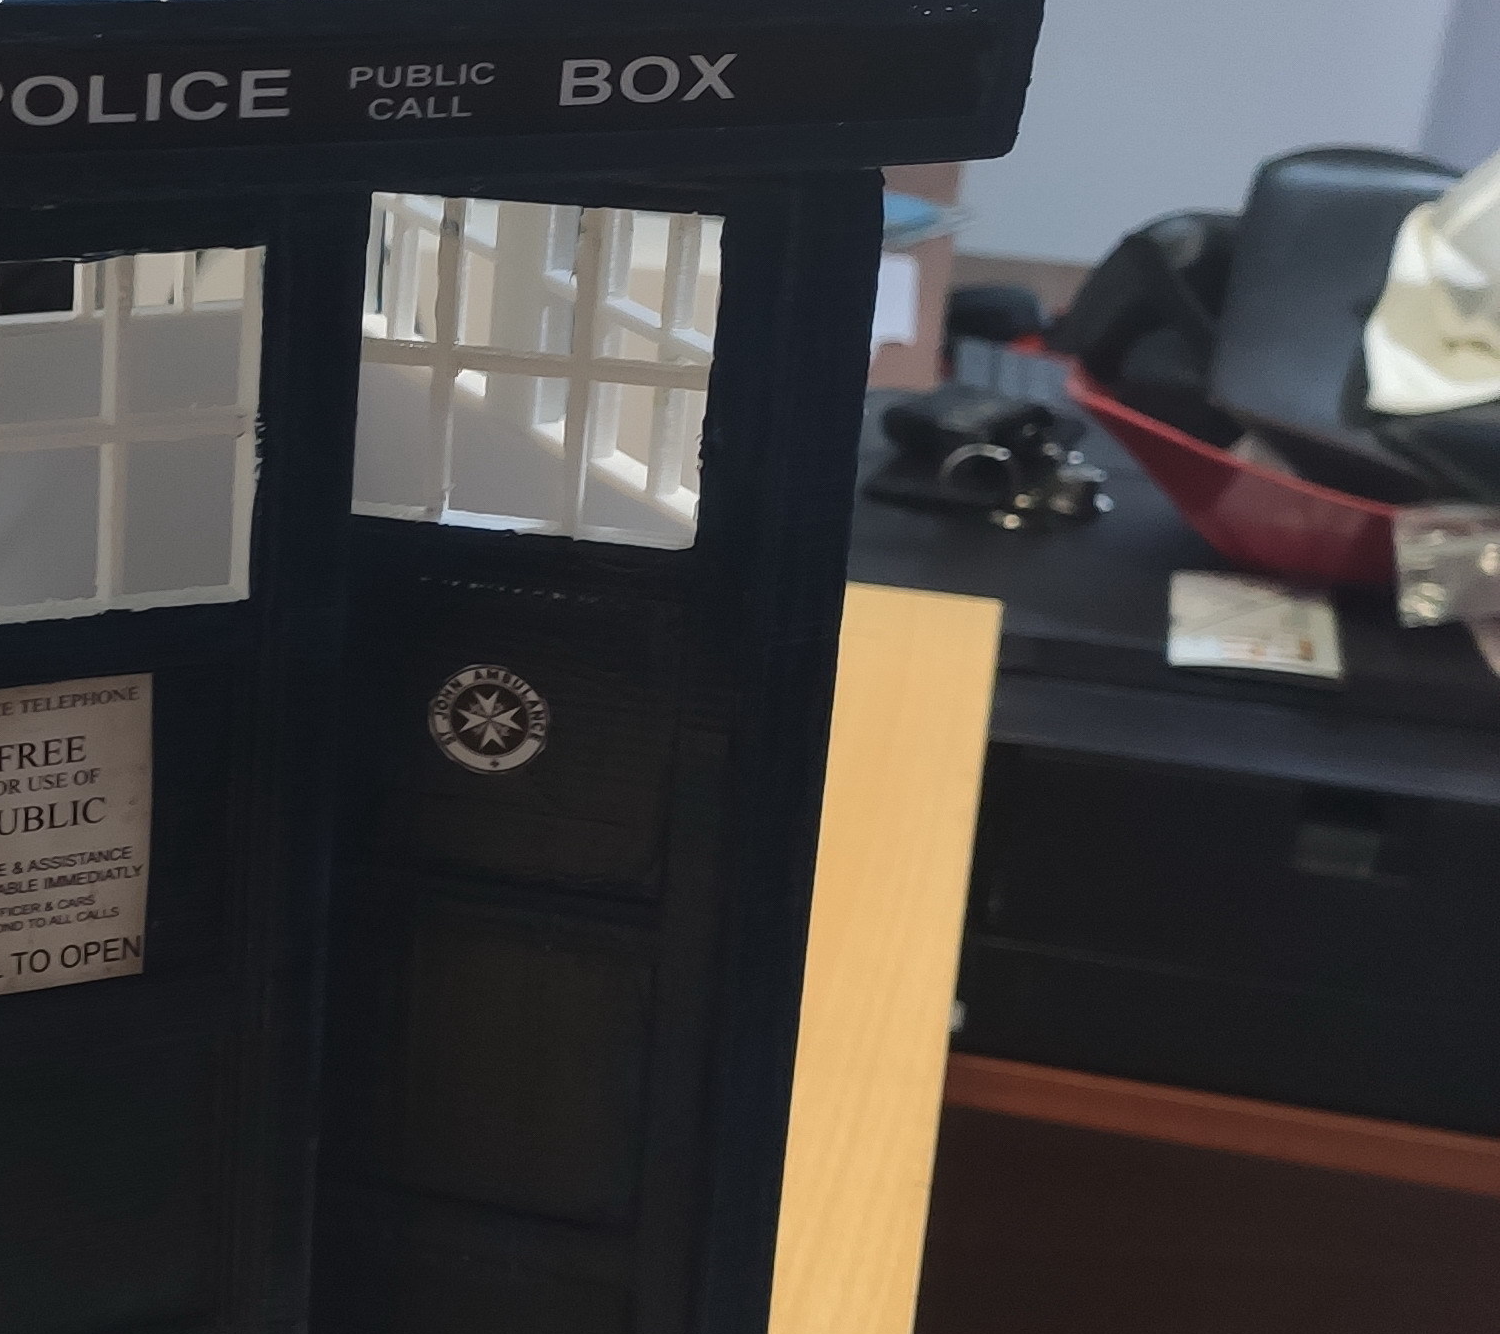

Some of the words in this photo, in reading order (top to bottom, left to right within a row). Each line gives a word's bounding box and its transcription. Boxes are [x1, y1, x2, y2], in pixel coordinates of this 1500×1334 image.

[348, 62, 497, 90] PUBLIC
[557, 53, 738, 107] BOX
[367, 95, 473, 121] CALL
[19, 685, 140, 714] TELEPHONE
[27, 771, 69, 792] USE
[73, 767, 101, 786] OF
[11, 861, 23, 874] &
[27, 845, 133, 873] ASSISTANCE
[44, 900, 54, 912] &
[57, 894, 96, 910] CARS
[27, 917, 46, 929] TO
[49, 914, 71, 926] ALL
[76, 906, 120, 922] CALLS
[11, 948, 51, 975] TO
[60, 935, 142, 969] OPEN
